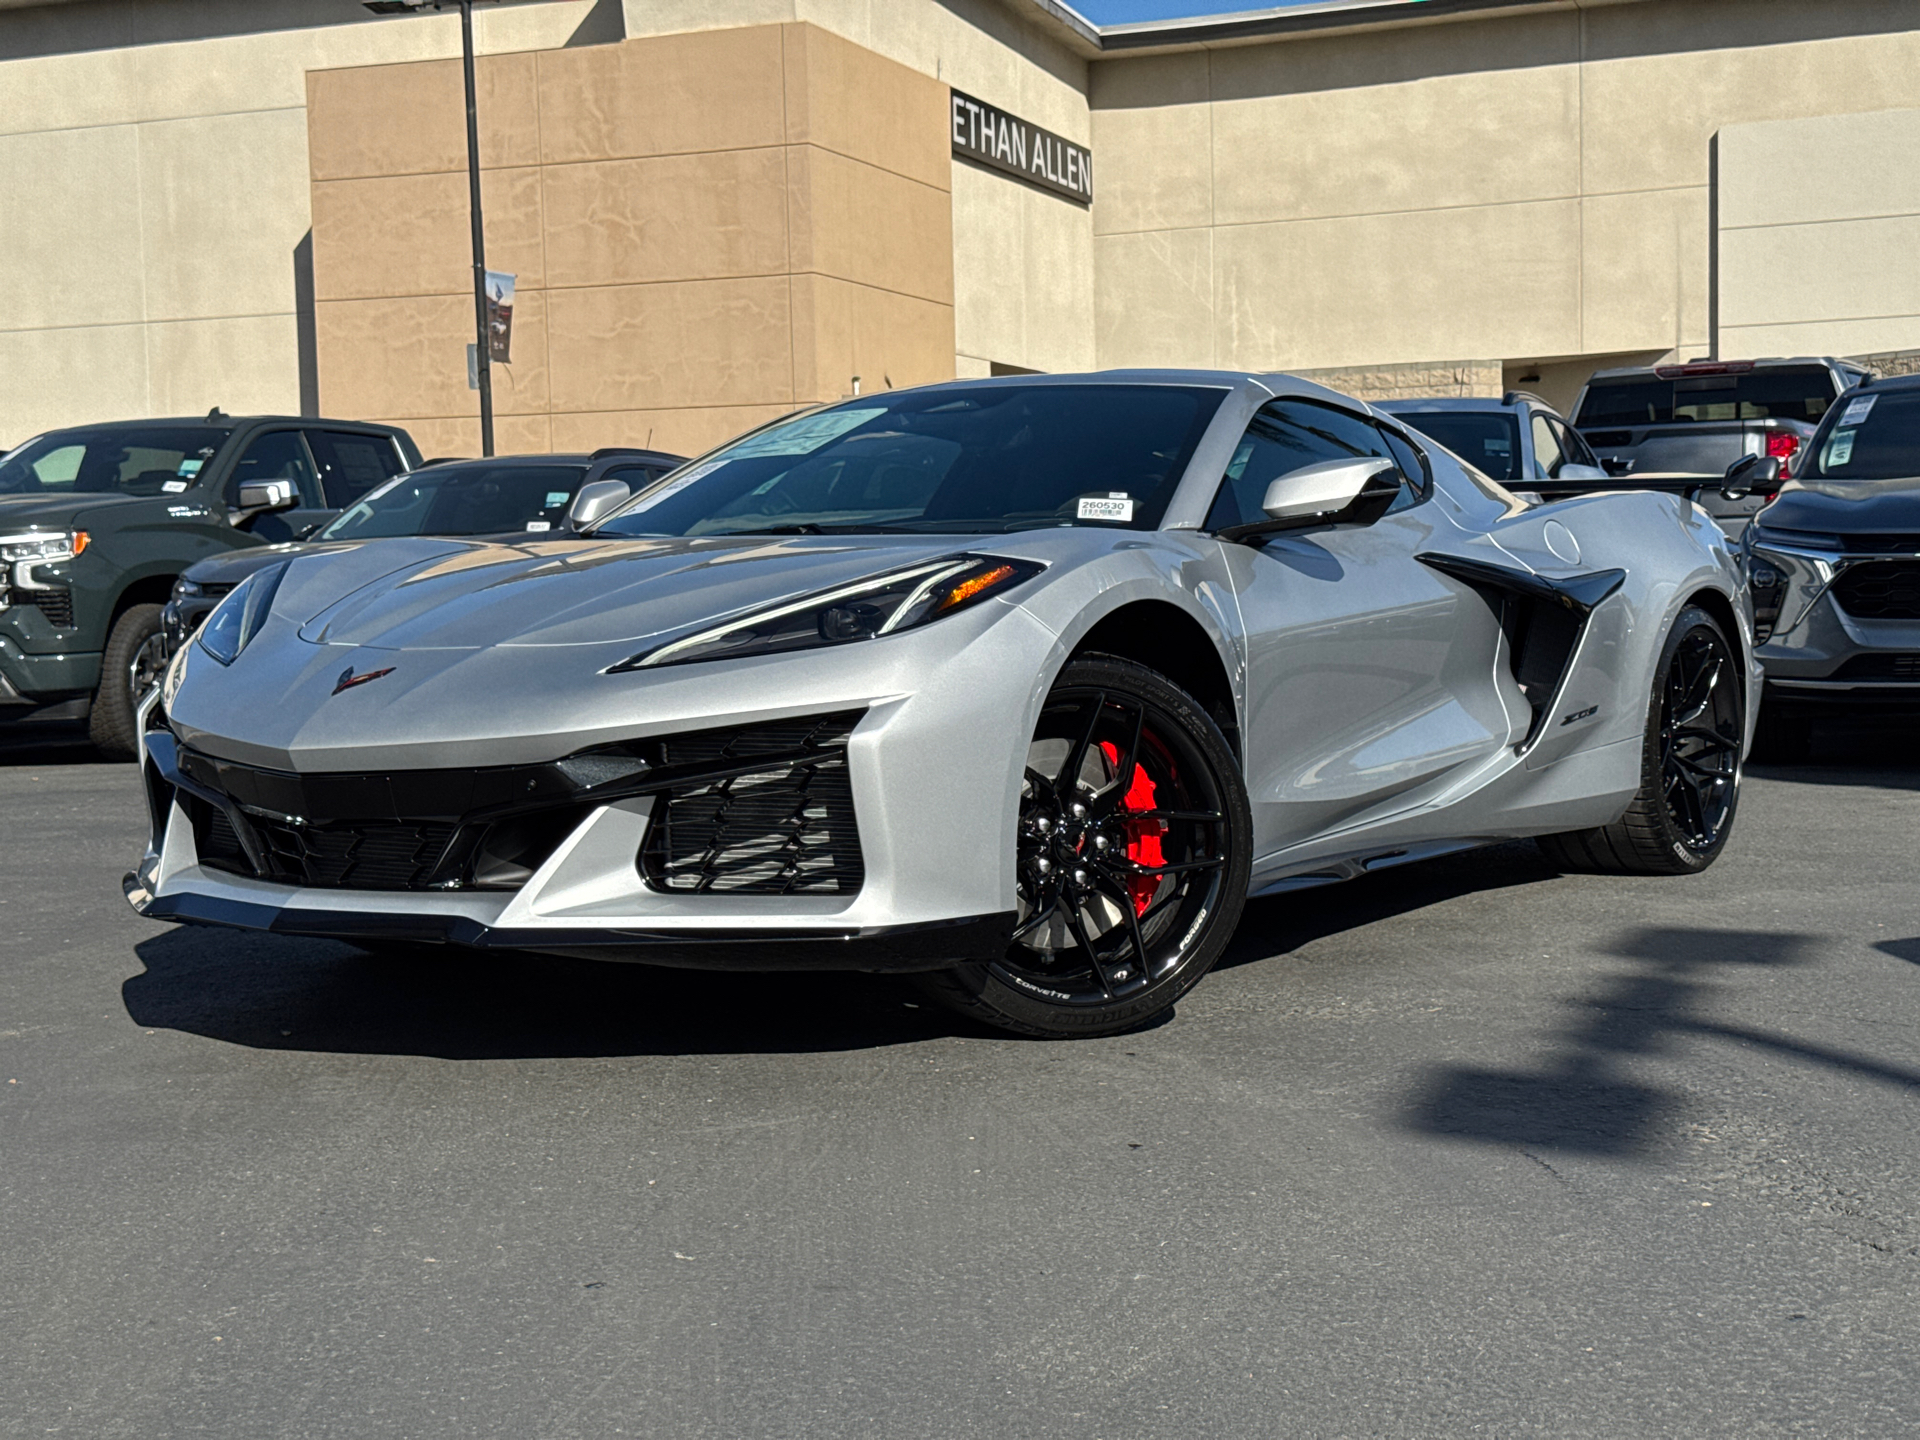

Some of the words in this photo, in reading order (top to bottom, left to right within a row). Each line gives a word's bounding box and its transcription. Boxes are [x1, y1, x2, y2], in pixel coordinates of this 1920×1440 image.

[953, 95, 1026, 170] ETHAN
[1031, 132, 1092, 197] ALLEN
[1082, 501, 1124, 510] 260530
[1560, 705, 1599, 726] Z06
[1179, 908, 1208, 951] FORGED
[1015, 977, 1072, 1000] CORVETTE
